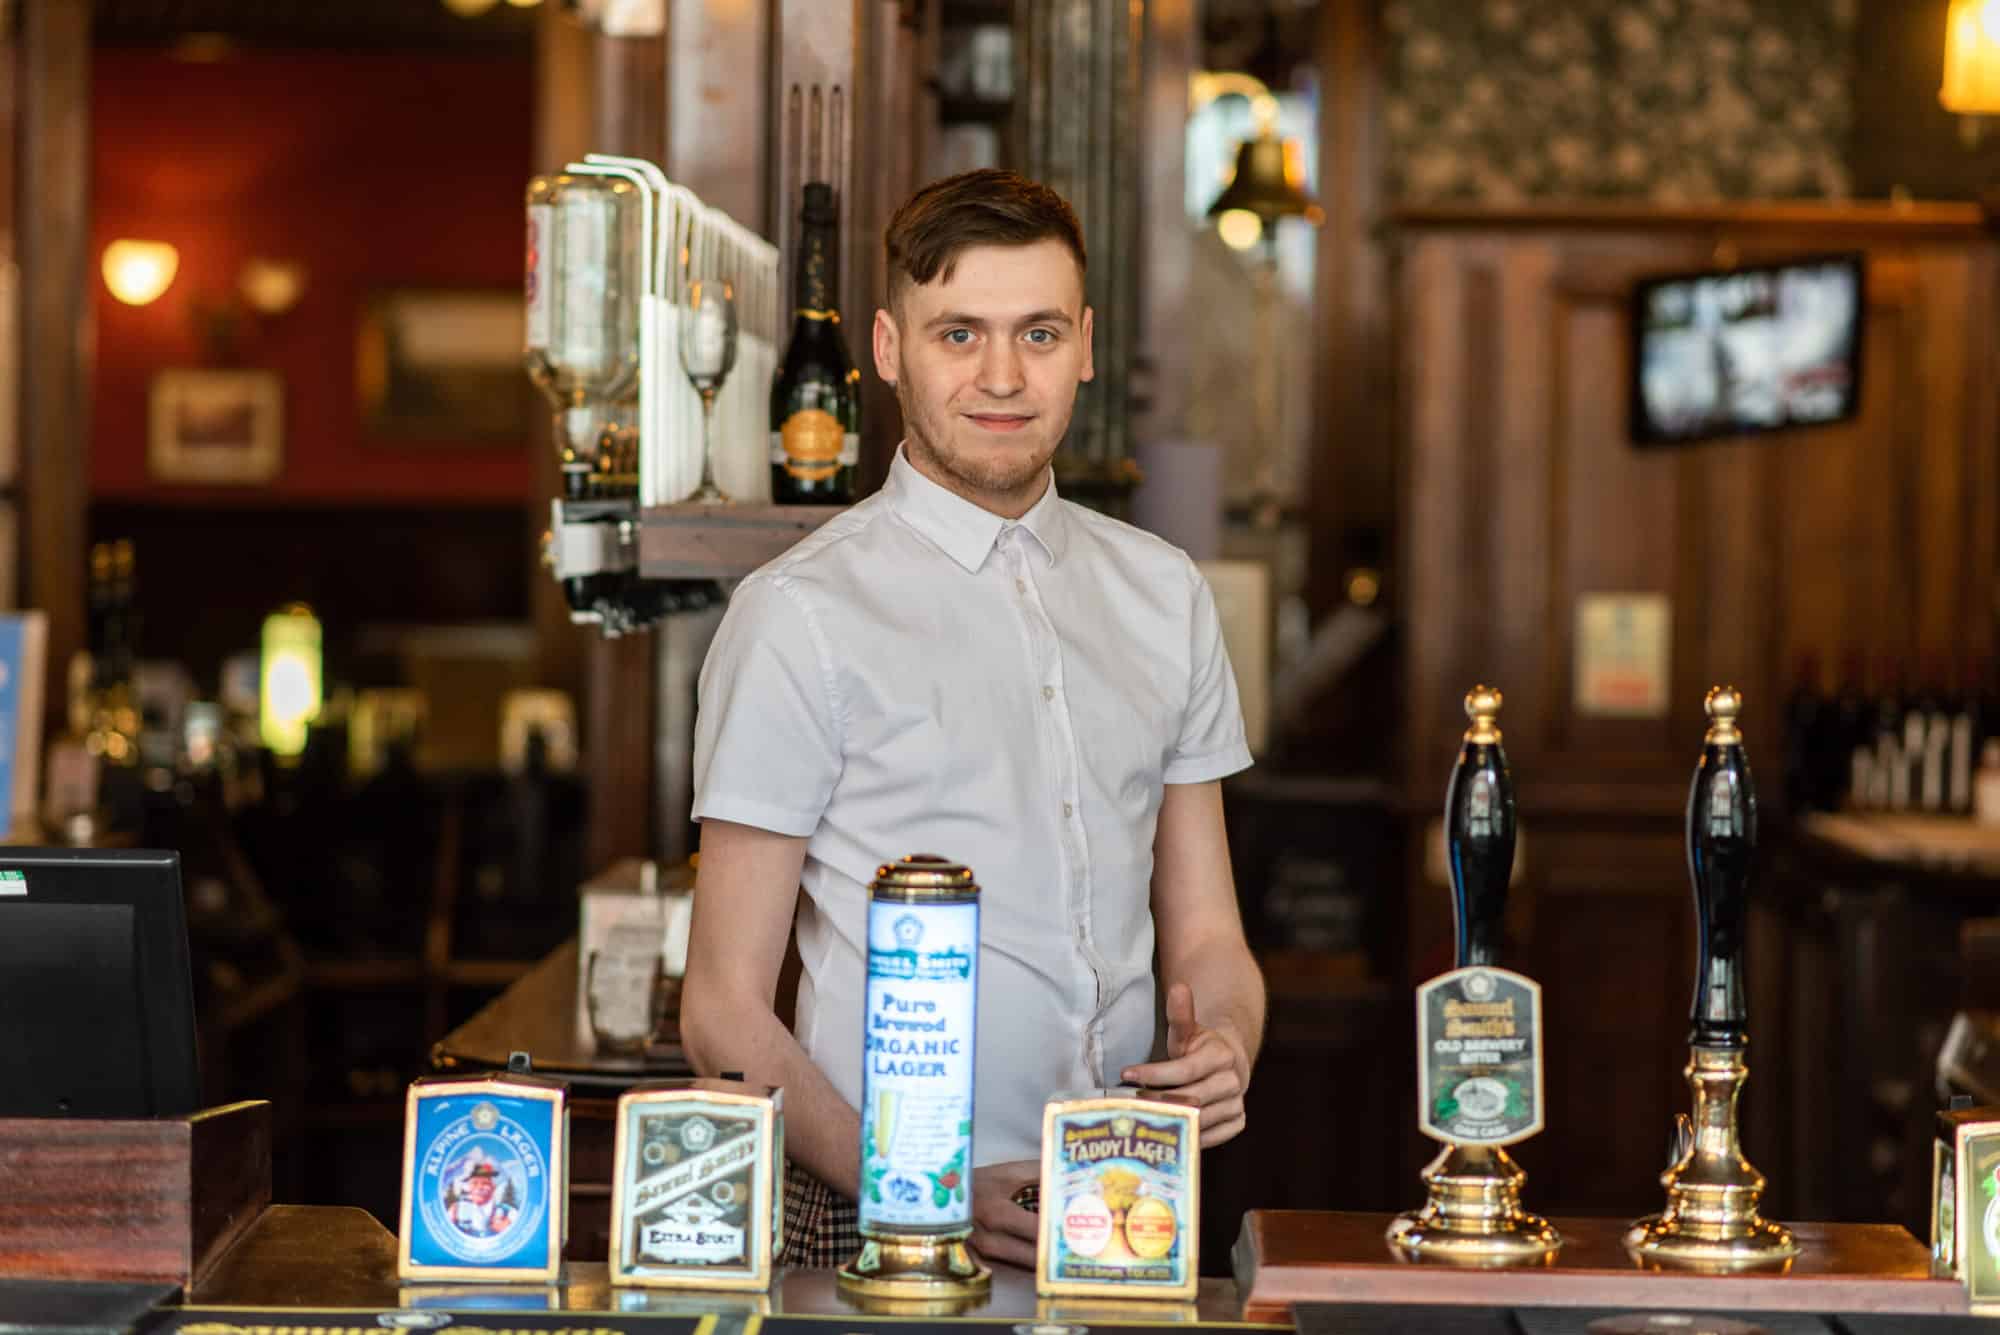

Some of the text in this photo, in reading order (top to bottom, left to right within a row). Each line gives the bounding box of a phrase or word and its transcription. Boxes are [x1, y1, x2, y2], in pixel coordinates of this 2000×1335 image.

[874, 1056, 946, 1077] LAGER
[427, 1122, 540, 1177] ALPINE LAGER
[1065, 1137, 1177, 1164] TADDY LAGER
